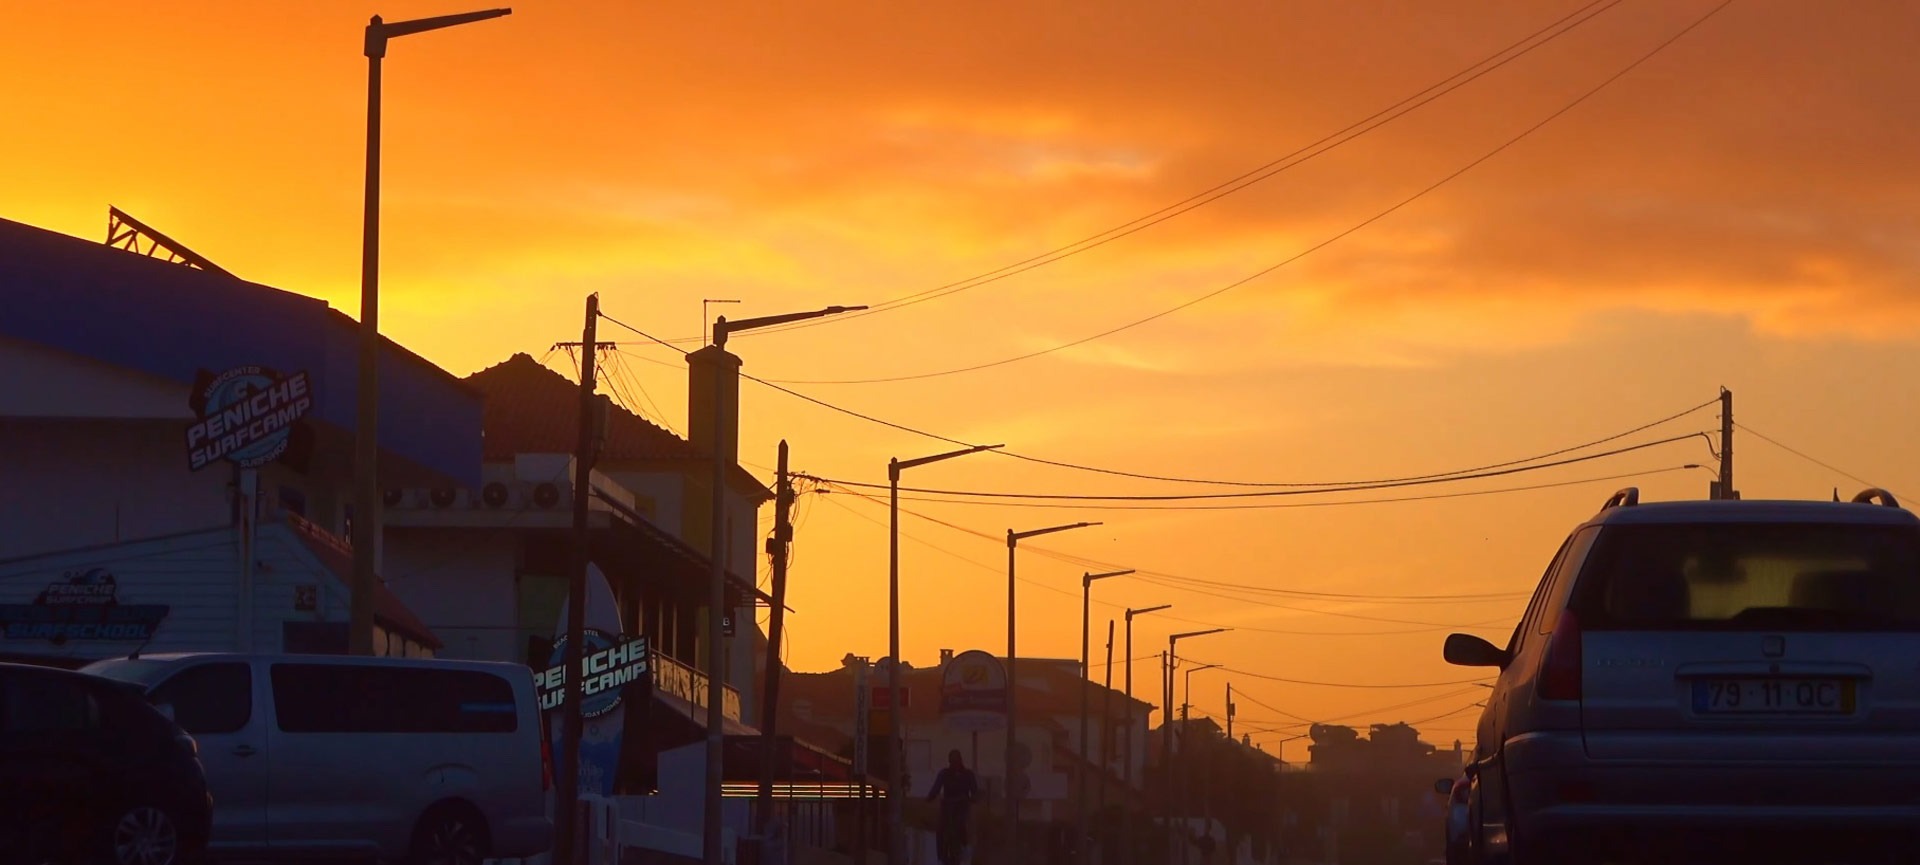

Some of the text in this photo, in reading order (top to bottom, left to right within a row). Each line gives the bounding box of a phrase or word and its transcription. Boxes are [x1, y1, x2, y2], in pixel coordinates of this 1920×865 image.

[187, 373, 307, 449] PENICHE
[190, 397, 310, 470] SURFCAMP
[47, 584, 115, 595] PENICHE
[6, 624, 150, 639] SURFSCHOOL
[537, 661, 648, 710] URCAMP
